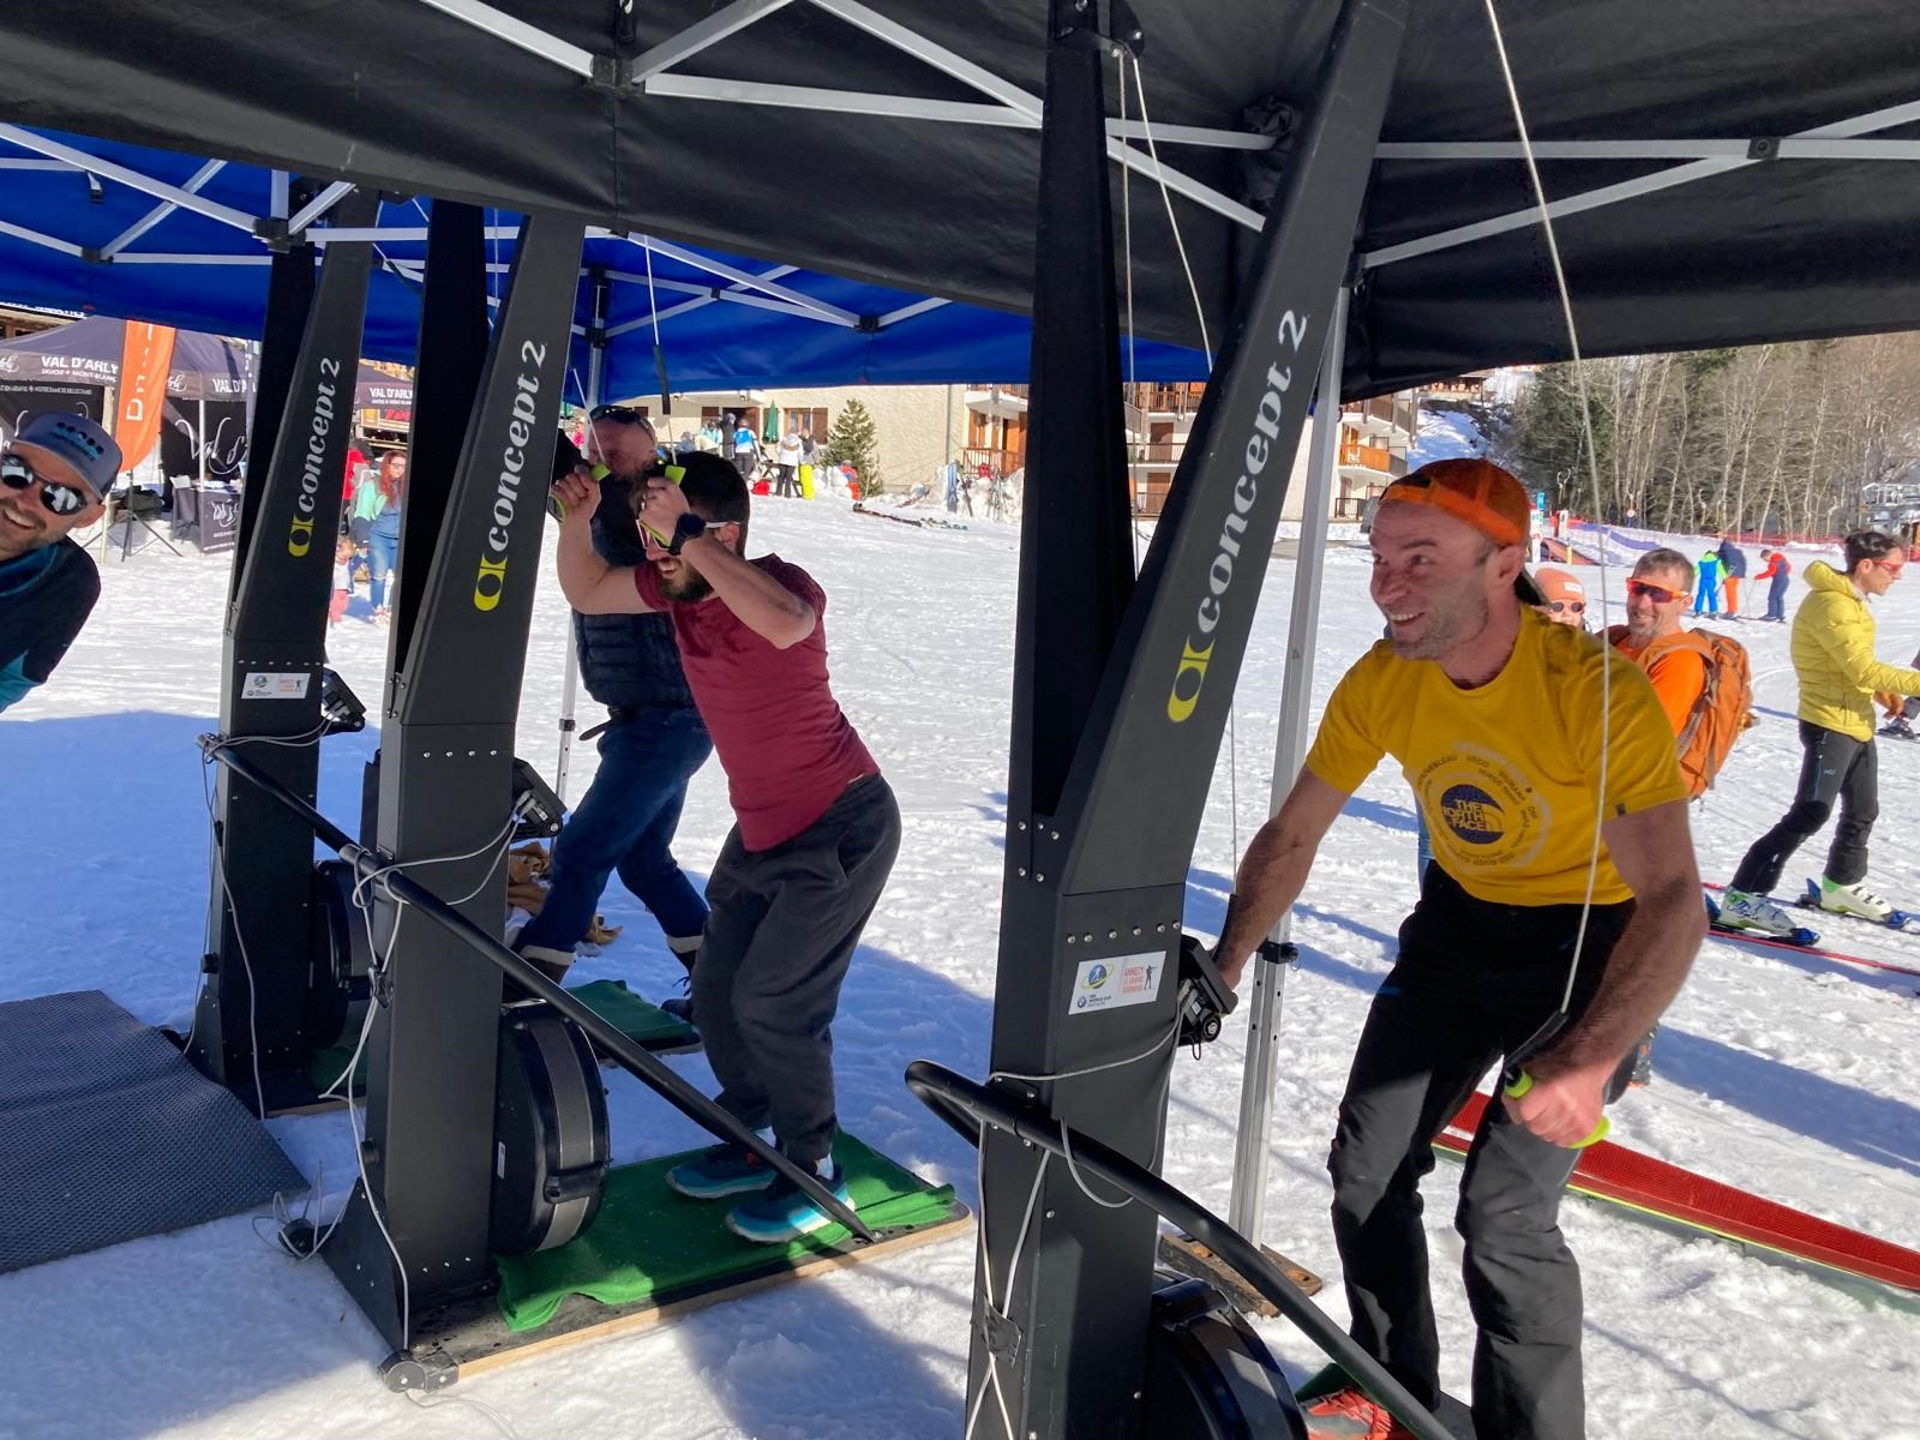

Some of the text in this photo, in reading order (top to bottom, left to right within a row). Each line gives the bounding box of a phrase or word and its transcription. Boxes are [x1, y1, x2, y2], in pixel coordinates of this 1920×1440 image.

[41, 355, 69, 368] VAL
[212, 378, 232, 393] VAL
[369, 387, 386, 398] VAL
[299, 357, 340, 513] concept 2
[489, 339, 546, 552] concept 2
[1198, 308, 1308, 633] concept 2
[1455, 798, 1482, 812] THE
[1452, 818, 1485, 831] FACE
